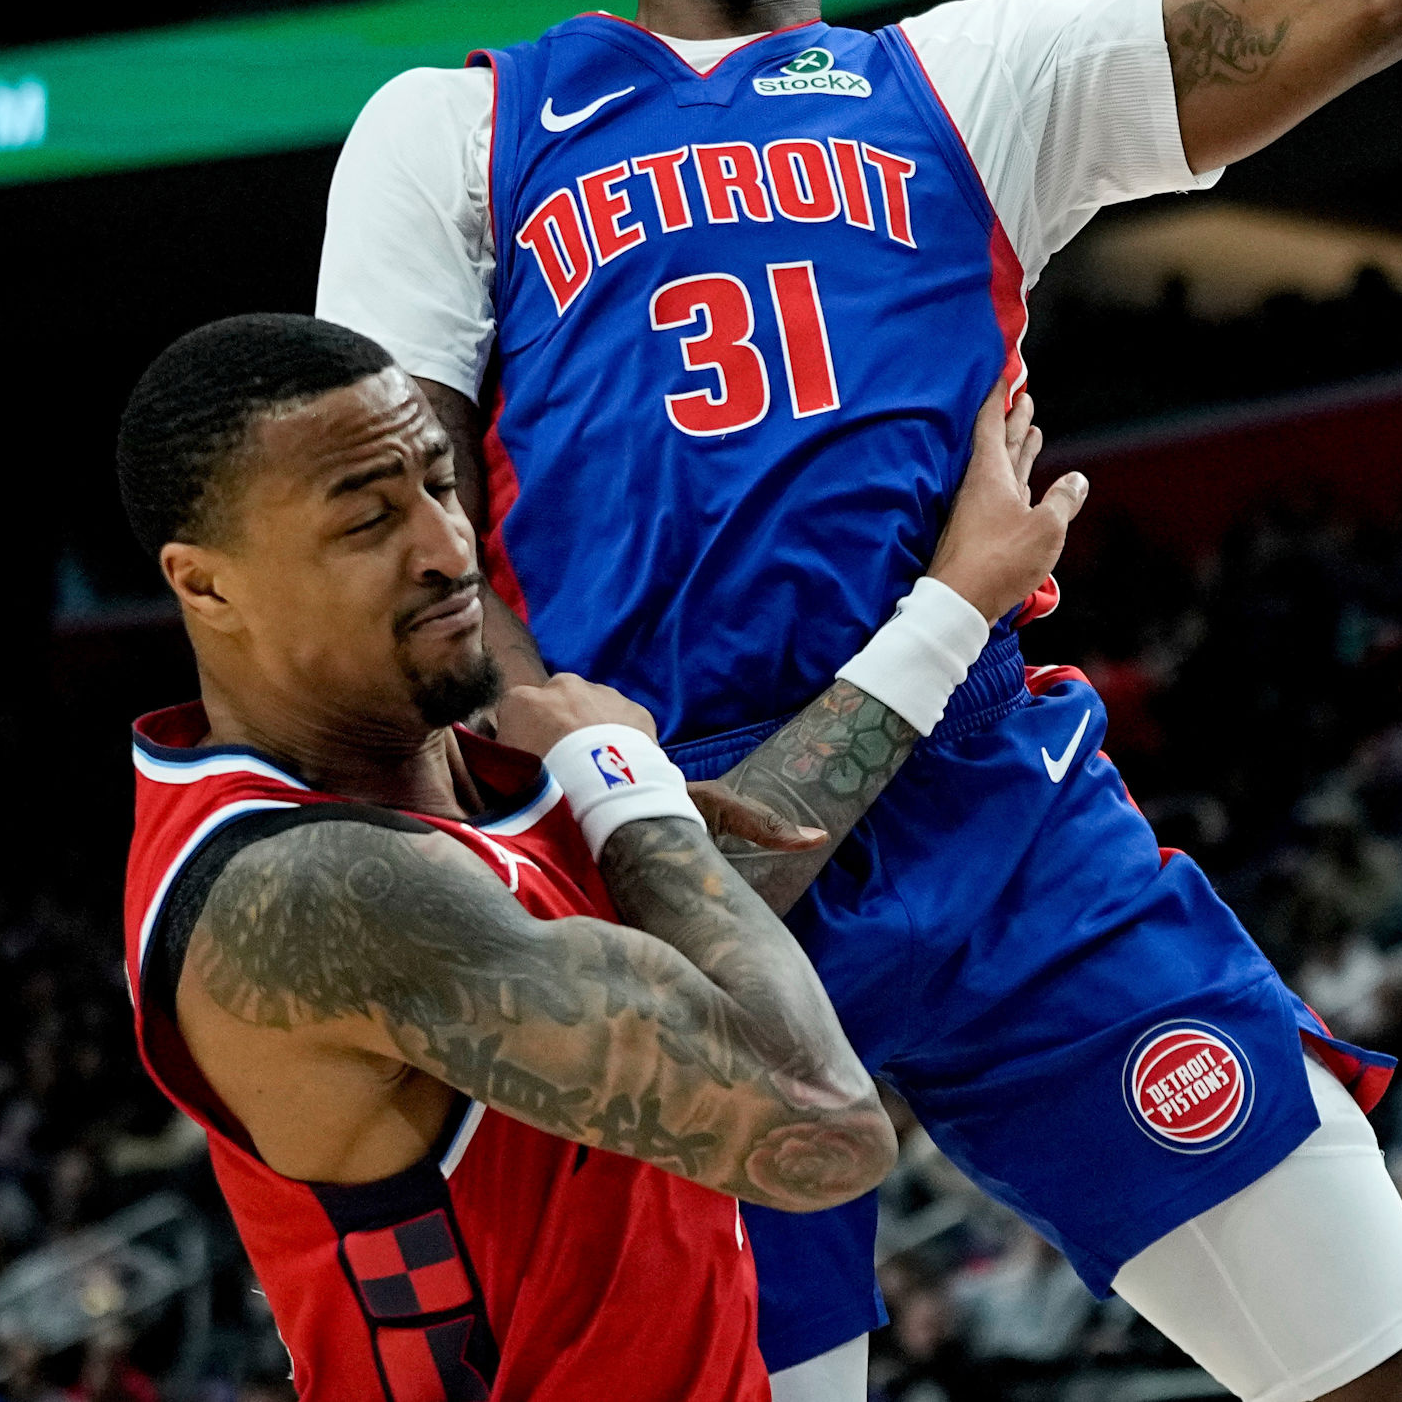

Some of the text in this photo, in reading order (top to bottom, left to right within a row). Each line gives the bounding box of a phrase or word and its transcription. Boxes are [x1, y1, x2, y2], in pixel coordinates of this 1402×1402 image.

[759, 74, 867, 93] StockX
[516, 138, 917, 317] DETROIT
[649, 260, 841, 438] 31
[1146, 1048, 1217, 1105] DETROIT
[1157, 1065, 1230, 1123] PISTONS
